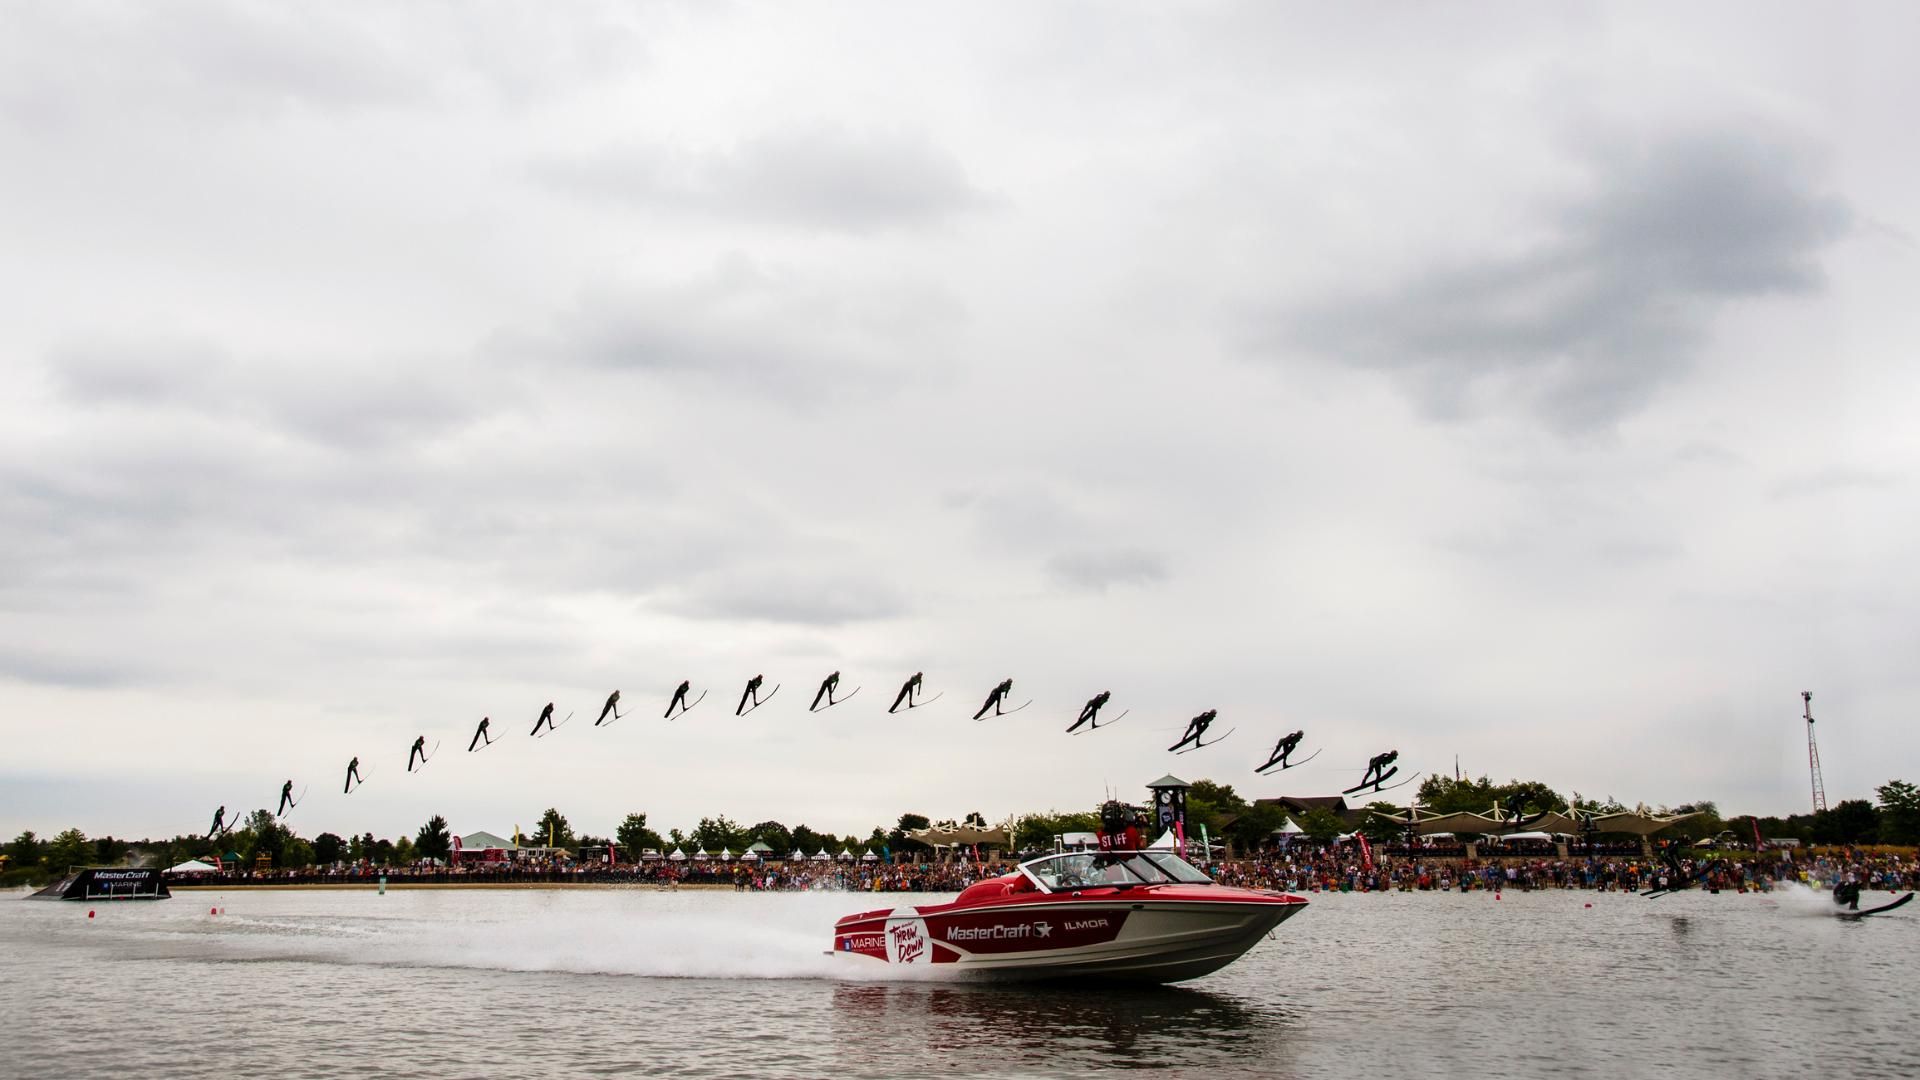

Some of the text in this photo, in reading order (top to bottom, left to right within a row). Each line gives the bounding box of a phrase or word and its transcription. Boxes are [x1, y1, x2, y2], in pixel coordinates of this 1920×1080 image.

[94, 871, 150, 879] MasterCraft
[947, 923, 1031, 941] MasterCraft
[1064, 919, 1109, 930] ILMOR
[851, 936, 885, 948] MARINE
[889, 925, 917, 948] THROW
[898, 936, 924, 963] DOWN
